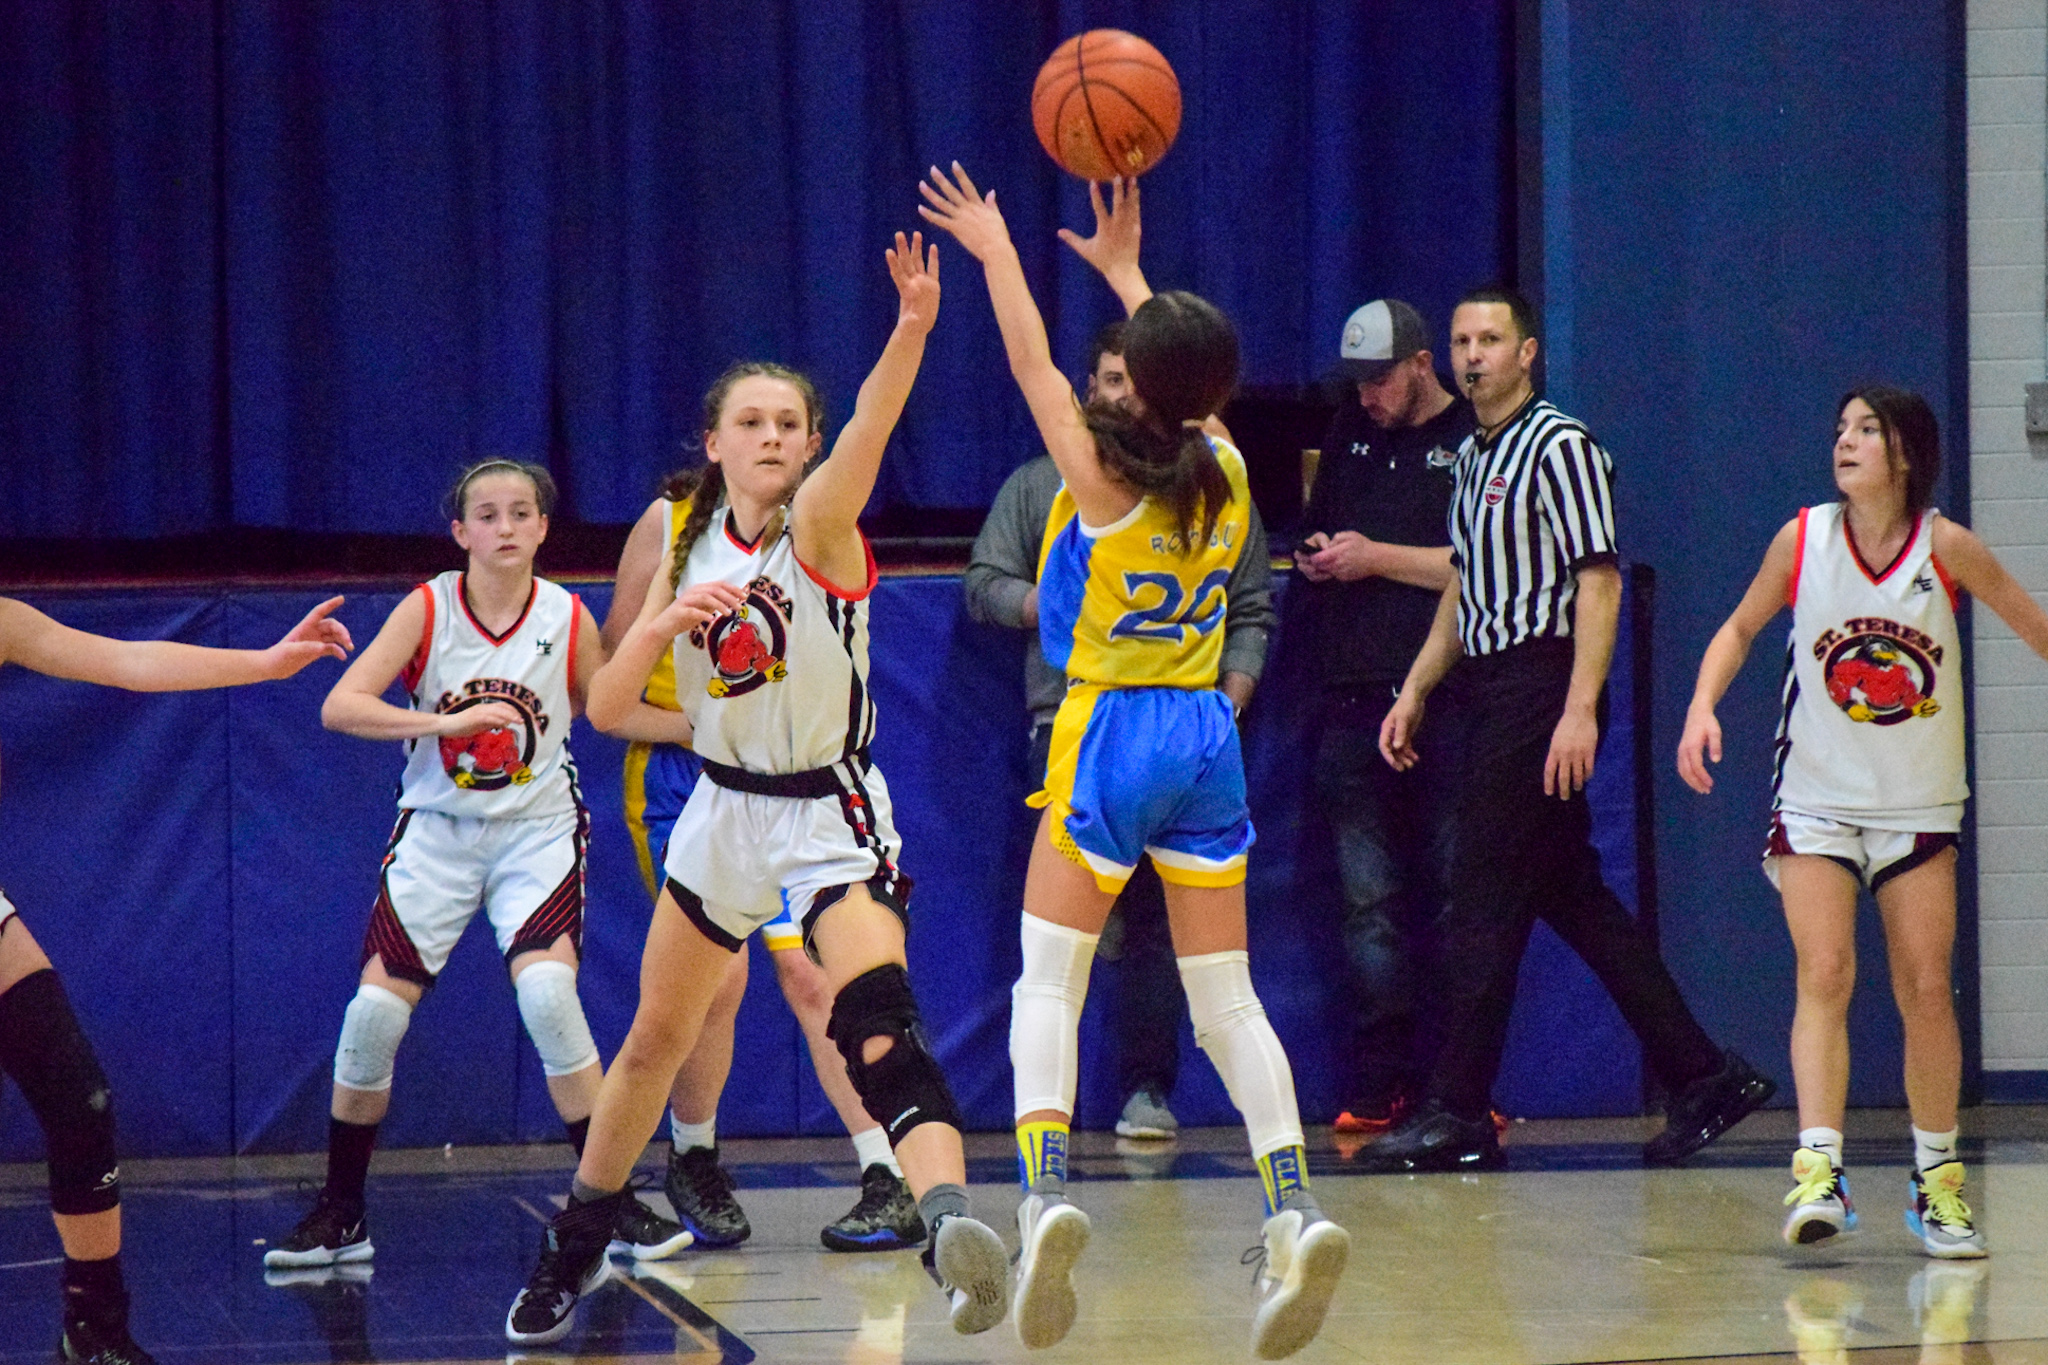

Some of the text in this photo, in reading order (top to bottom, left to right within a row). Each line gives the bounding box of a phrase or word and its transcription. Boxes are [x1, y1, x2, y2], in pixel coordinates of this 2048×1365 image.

[1108, 566, 1232, 646] 20
[1813, 616, 1944, 668] ST. TERESA
[463, 677, 550, 737] TERESA
